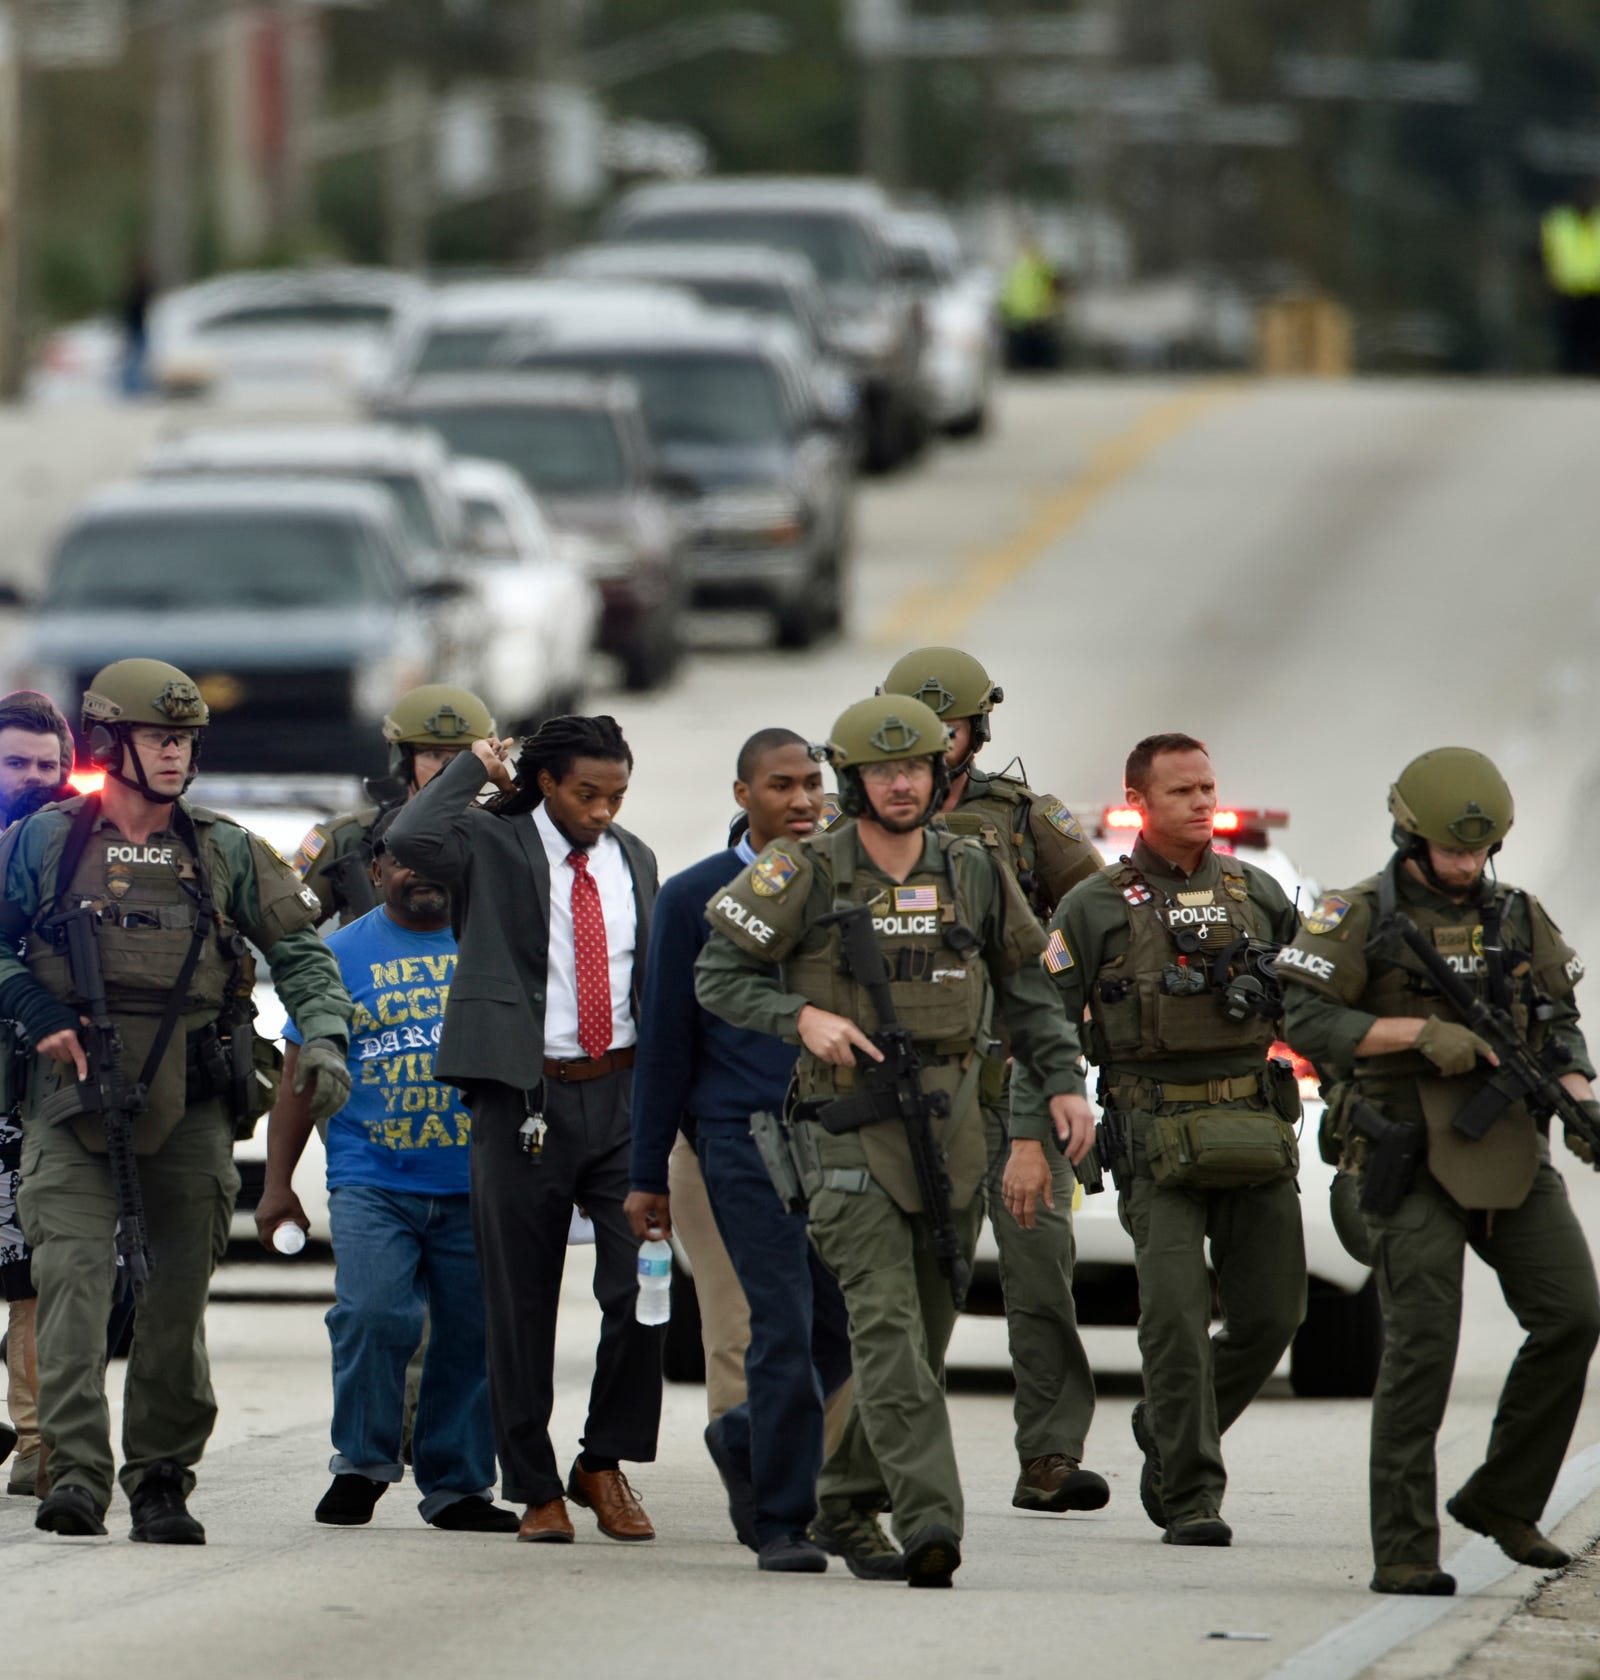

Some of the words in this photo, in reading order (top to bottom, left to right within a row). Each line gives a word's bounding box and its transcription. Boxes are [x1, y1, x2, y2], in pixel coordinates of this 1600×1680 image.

[107, 846, 172, 864] POLICE
[716, 895, 776, 944] POLICE
[872, 916, 937, 935] POLICE
[1168, 906, 1228, 926] POLICE
[1275, 947, 1336, 979] POLICE
[1446, 955, 1484, 973] OLIC
